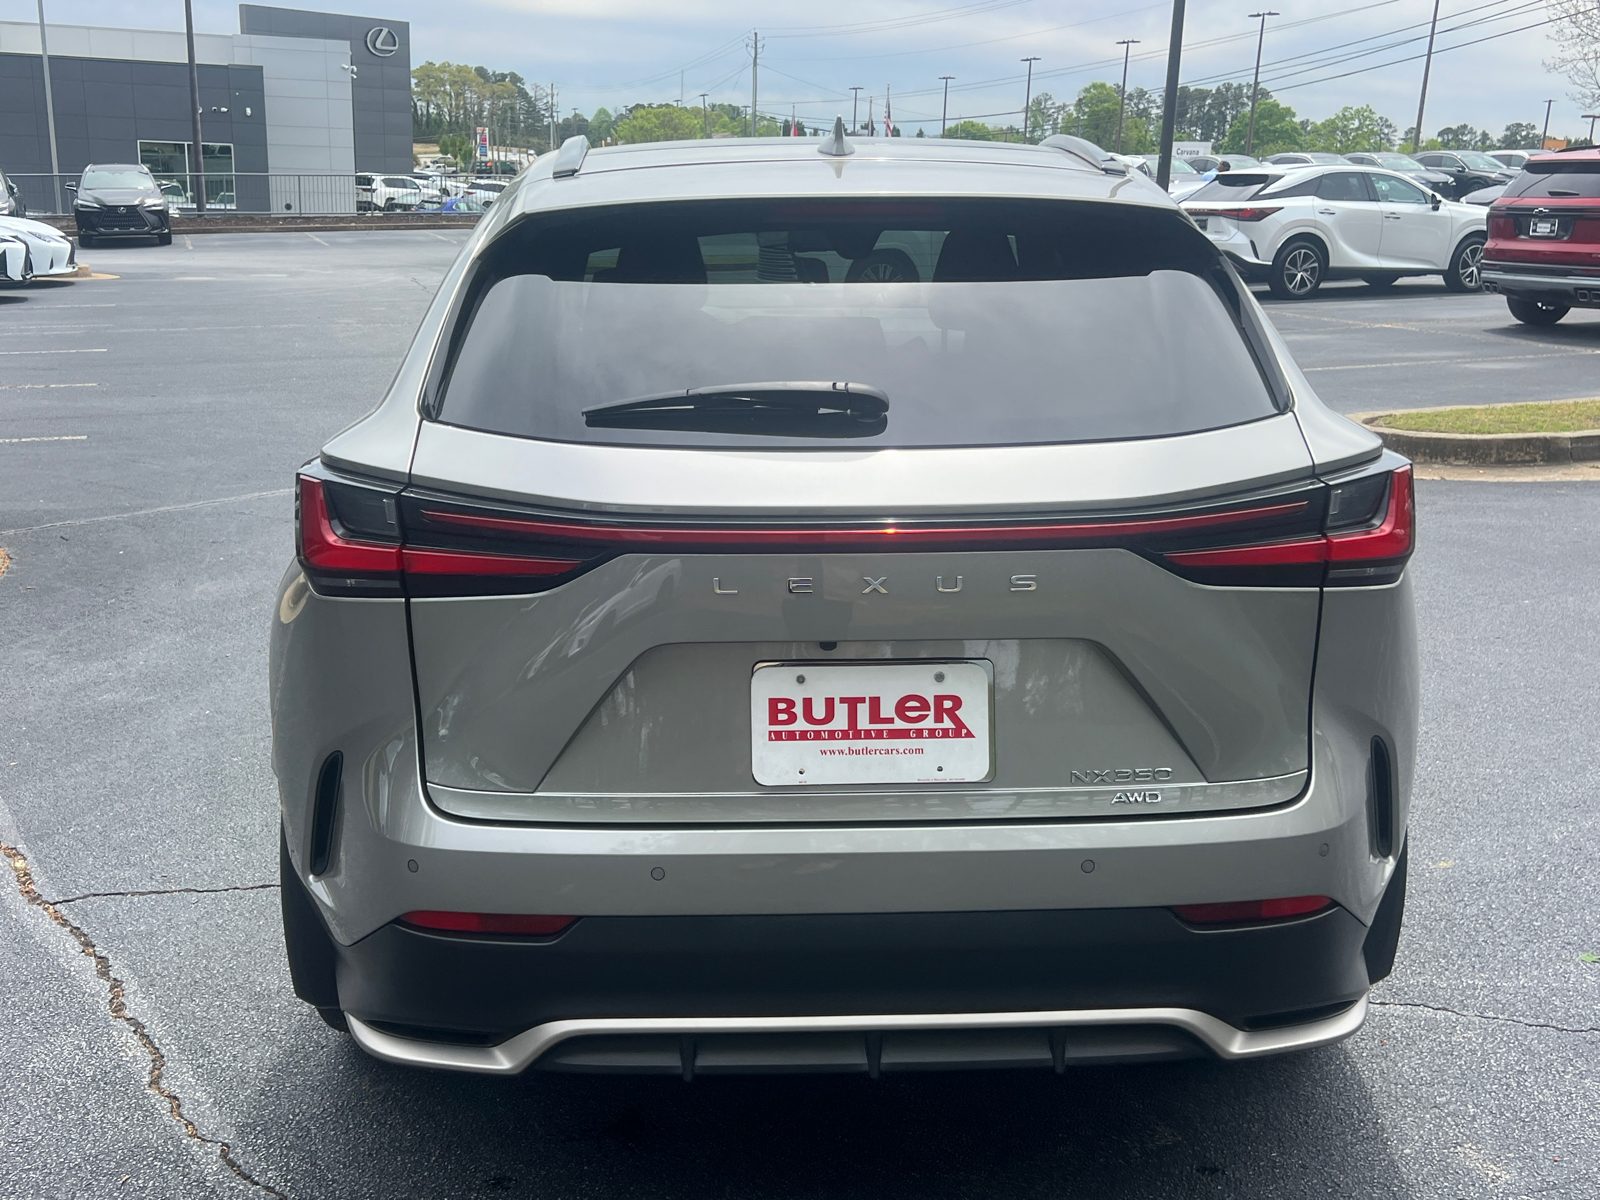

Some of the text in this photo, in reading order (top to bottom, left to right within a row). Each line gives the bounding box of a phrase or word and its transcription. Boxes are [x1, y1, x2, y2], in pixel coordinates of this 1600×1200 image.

[1176, 147, 1200, 156] Carvana
[712, 574, 1037, 595] LEXUS
[769, 728, 968, 740] AUTOMOTIVE GROUP
[819, 746, 925, 756] www.butlercars.com
[1110, 791, 1162, 805] AWD
